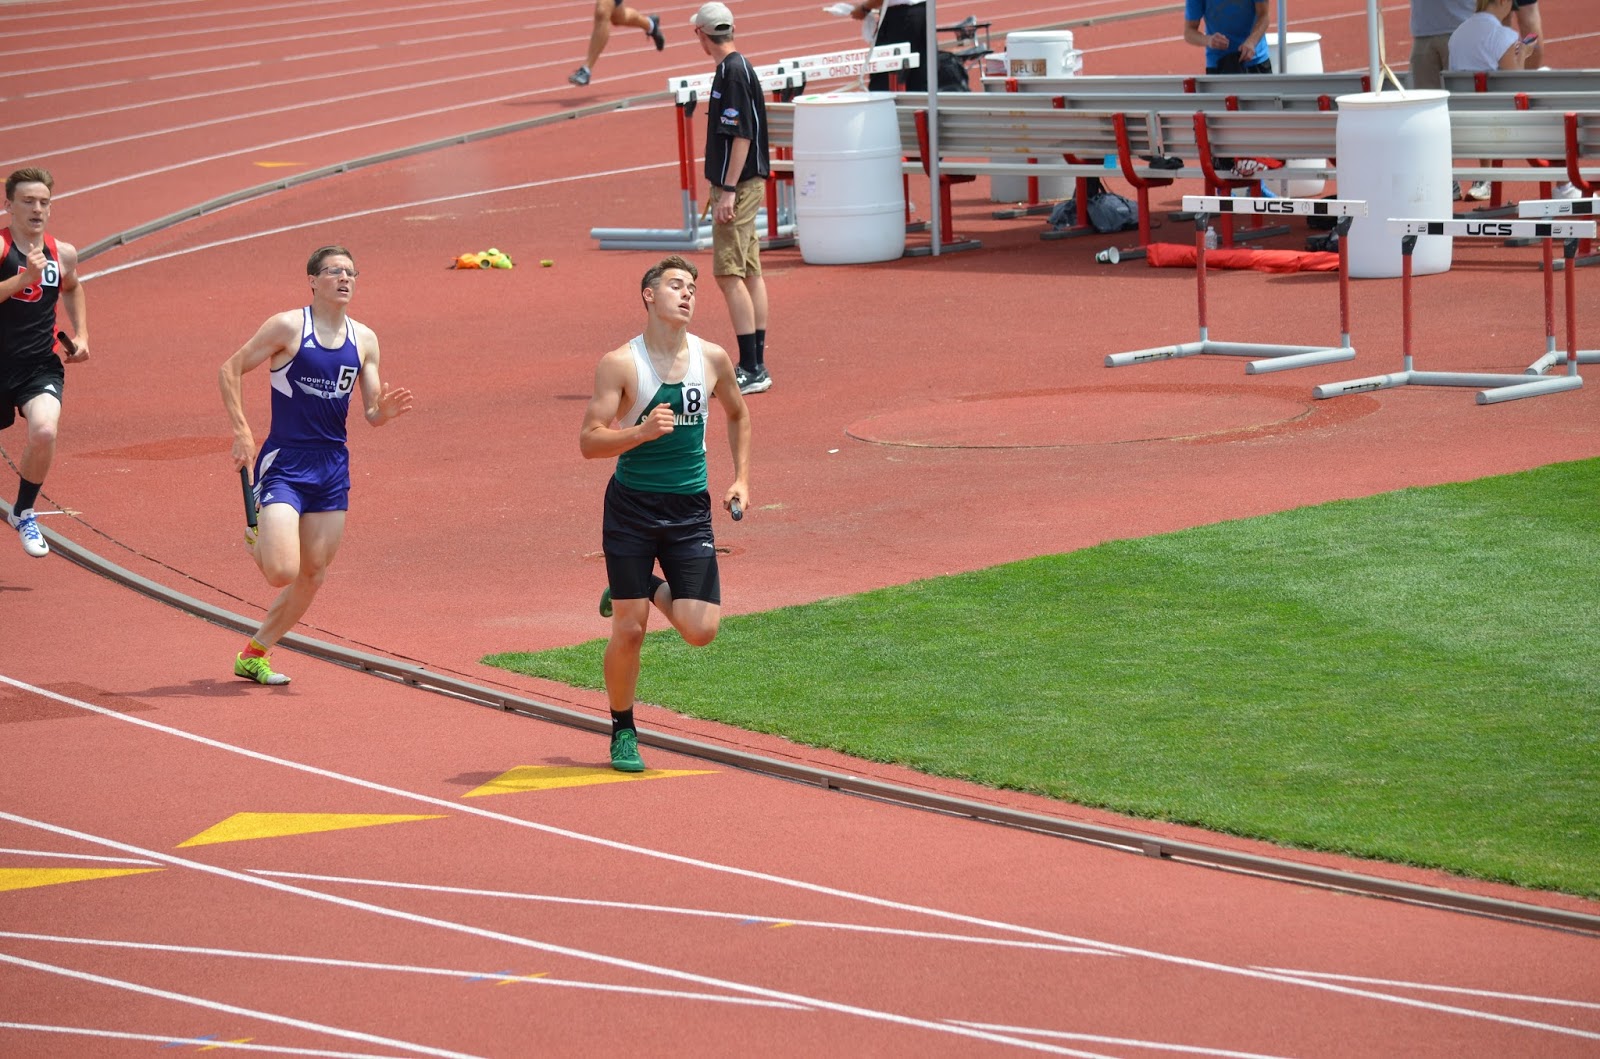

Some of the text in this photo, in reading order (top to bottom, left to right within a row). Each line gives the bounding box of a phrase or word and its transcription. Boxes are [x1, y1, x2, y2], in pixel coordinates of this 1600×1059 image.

[822, 55, 842, 65] OHIO
[829, 65, 850, 77] OHIO
[1253, 201, 1294, 213] UCS
[1466, 223, 1512, 236] UCS
[44, 262, 57, 285] 6
[301, 376, 325, 384] MOUNT
[339, 368, 354, 390] 5
[686, 388, 701, 413] 8
